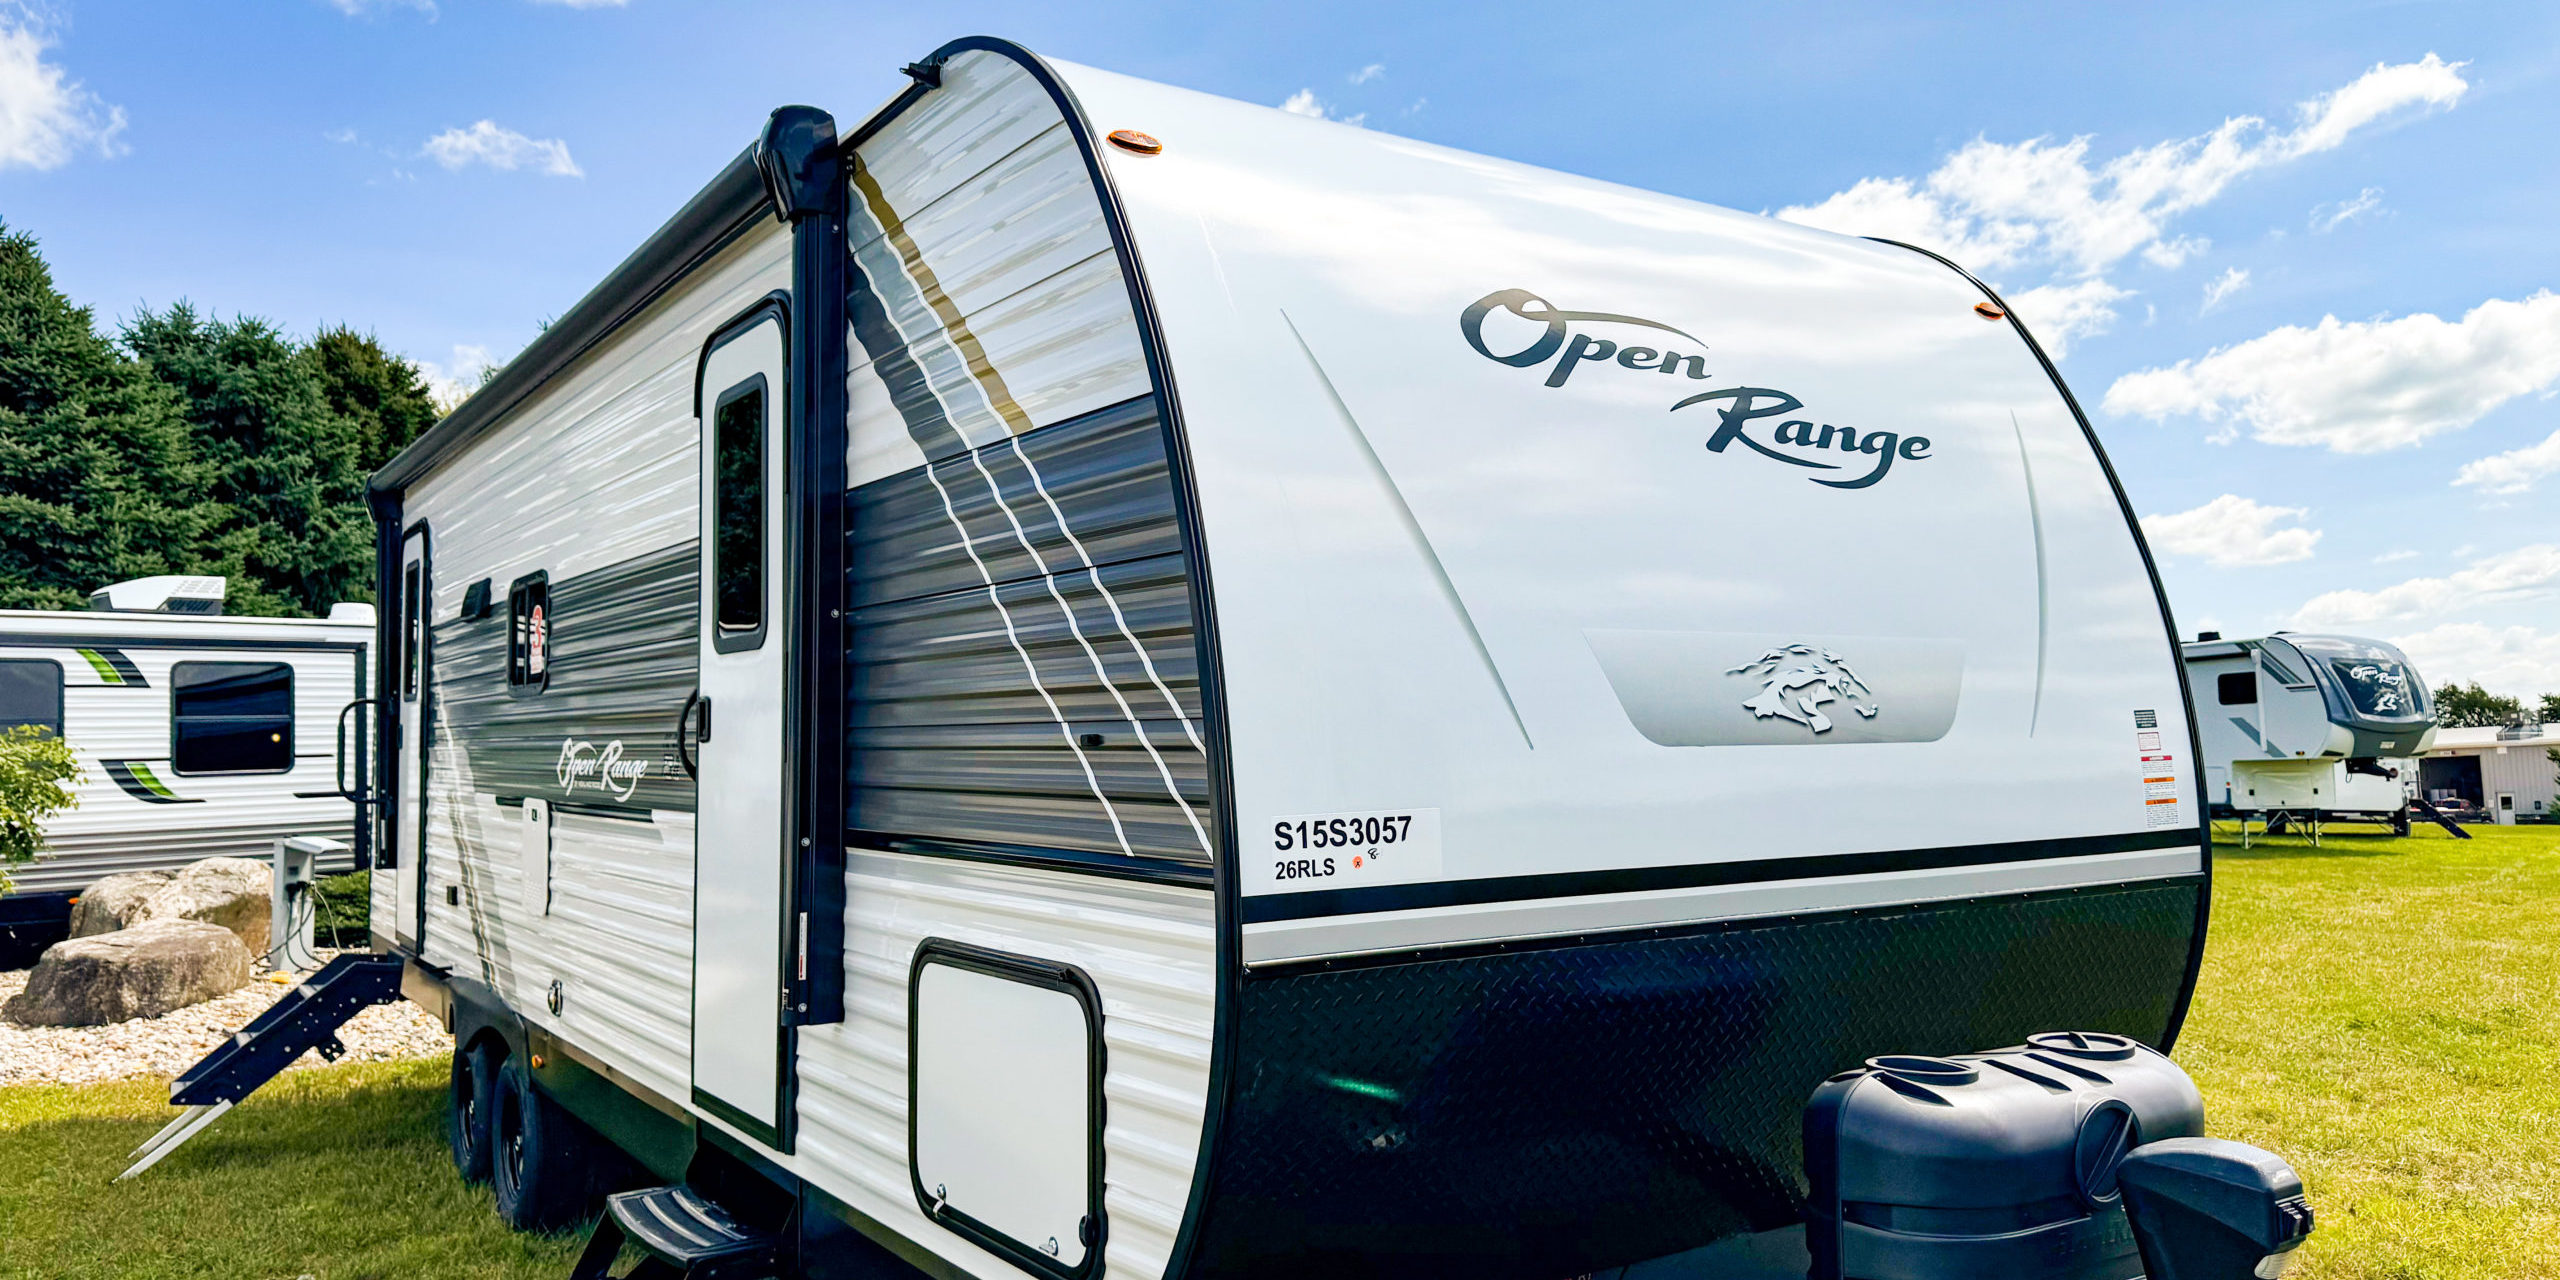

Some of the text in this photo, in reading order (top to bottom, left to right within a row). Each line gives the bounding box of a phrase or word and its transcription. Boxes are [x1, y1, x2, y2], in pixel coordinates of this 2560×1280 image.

[1460, 287, 1933, 490] Open Range
[2350, 665, 2378, 681] Open
[556, 737, 598, 797] Open
[595, 739, 649, 803] Range
[1274, 815, 1412, 851] S15S3057
[1275, 857, 1336, 880] 26RLS
